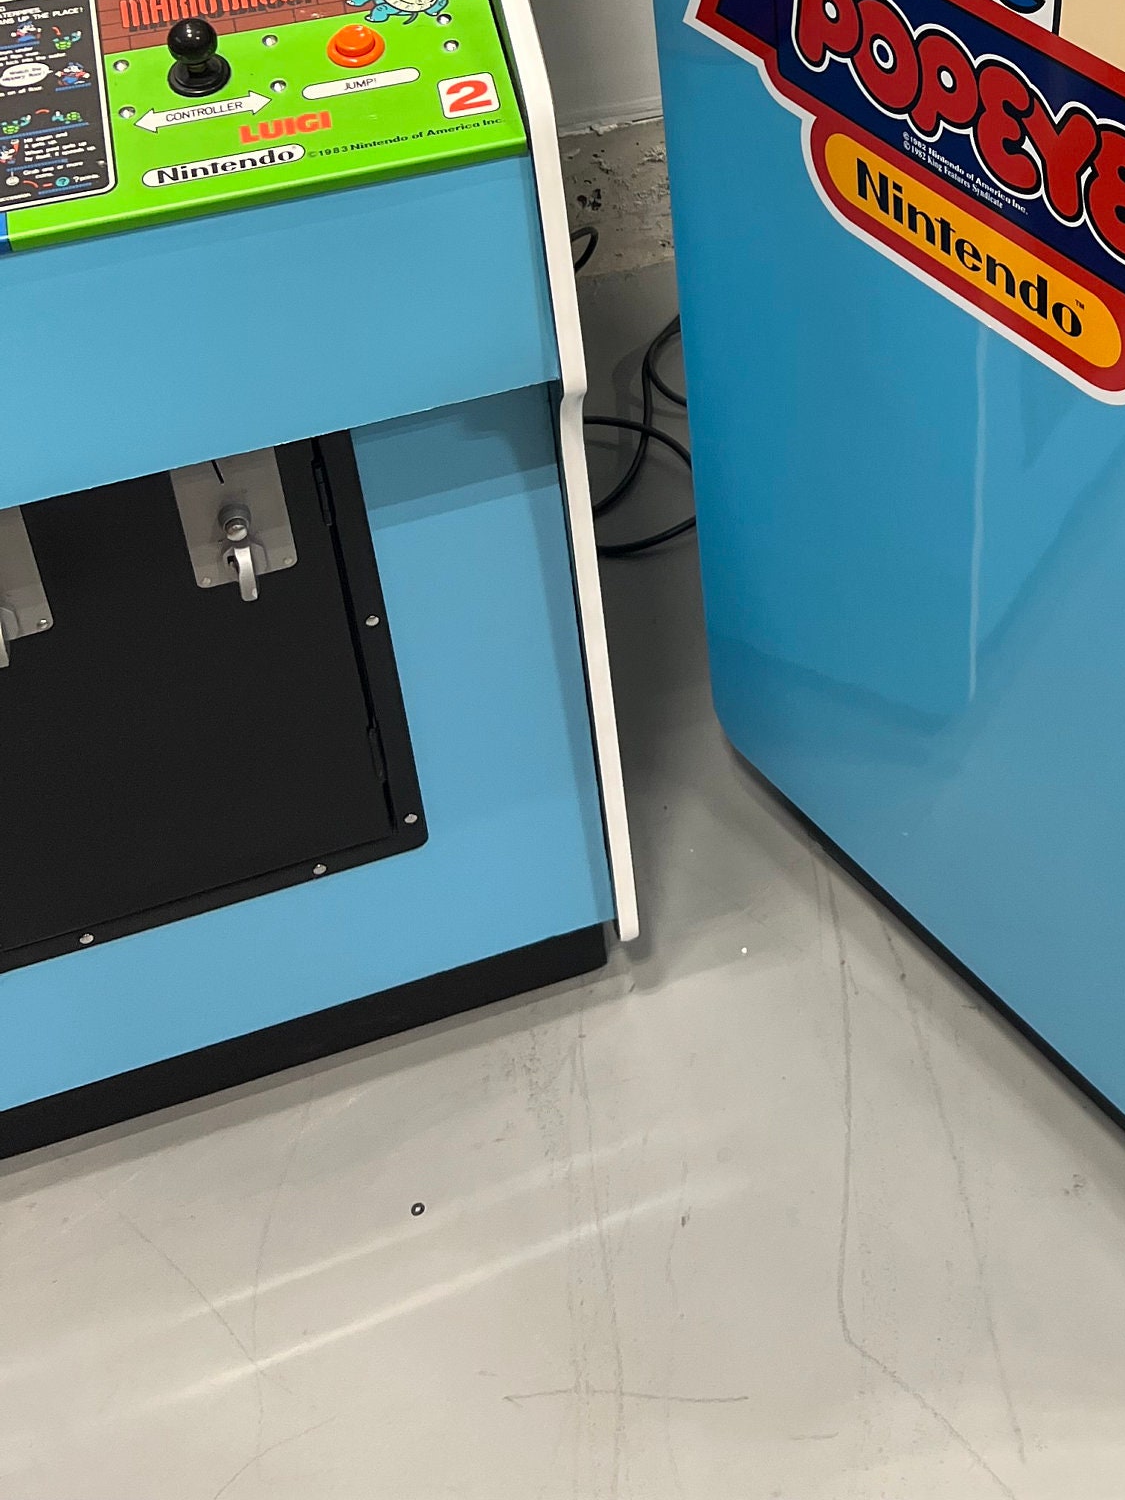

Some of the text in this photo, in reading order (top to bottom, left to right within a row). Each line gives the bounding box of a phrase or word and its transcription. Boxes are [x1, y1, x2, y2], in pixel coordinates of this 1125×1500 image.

[32, 12, 50, 20] THE
[344, 77, 377, 91] JUMP!
[446, 80, 493, 113] 2
[165, 101, 243, 123] CONTROLLER
[239, 111, 332, 145] LUIGI
[350, 134, 409, 151] Nintendo
[411, 131, 424, 140] of
[426, 120, 481, 137] America
[157, 148, 296, 185] Nintendo
[927, 156, 942, 173] King
[944, 165, 971, 189] Features
[972, 183, 1003, 209] Syndicate
[928, 147, 965, 175] Nintendo
[966, 172, 974, 181] of
[975, 177, 1011, 204] America
[856, 156, 1082, 338] Nintendo
